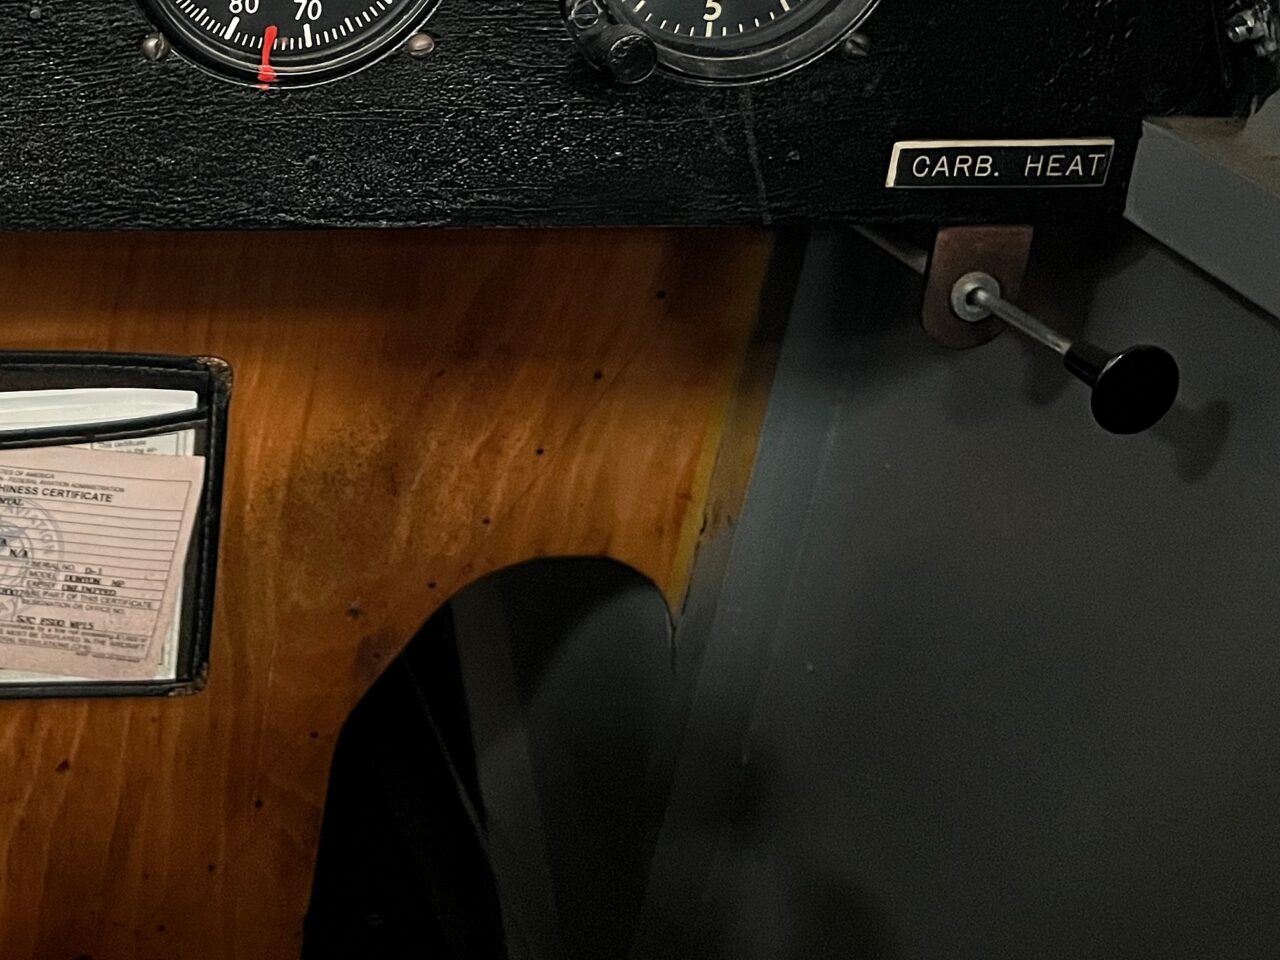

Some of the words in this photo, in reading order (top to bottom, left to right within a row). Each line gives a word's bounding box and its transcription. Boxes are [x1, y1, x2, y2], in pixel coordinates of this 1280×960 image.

[293, 0, 322, 20] 70
[912, 155, 999, 177] CARB.
[1024, 154, 1105, 176] HEAT
[42, 488, 114, 503] CERTIFICATE
